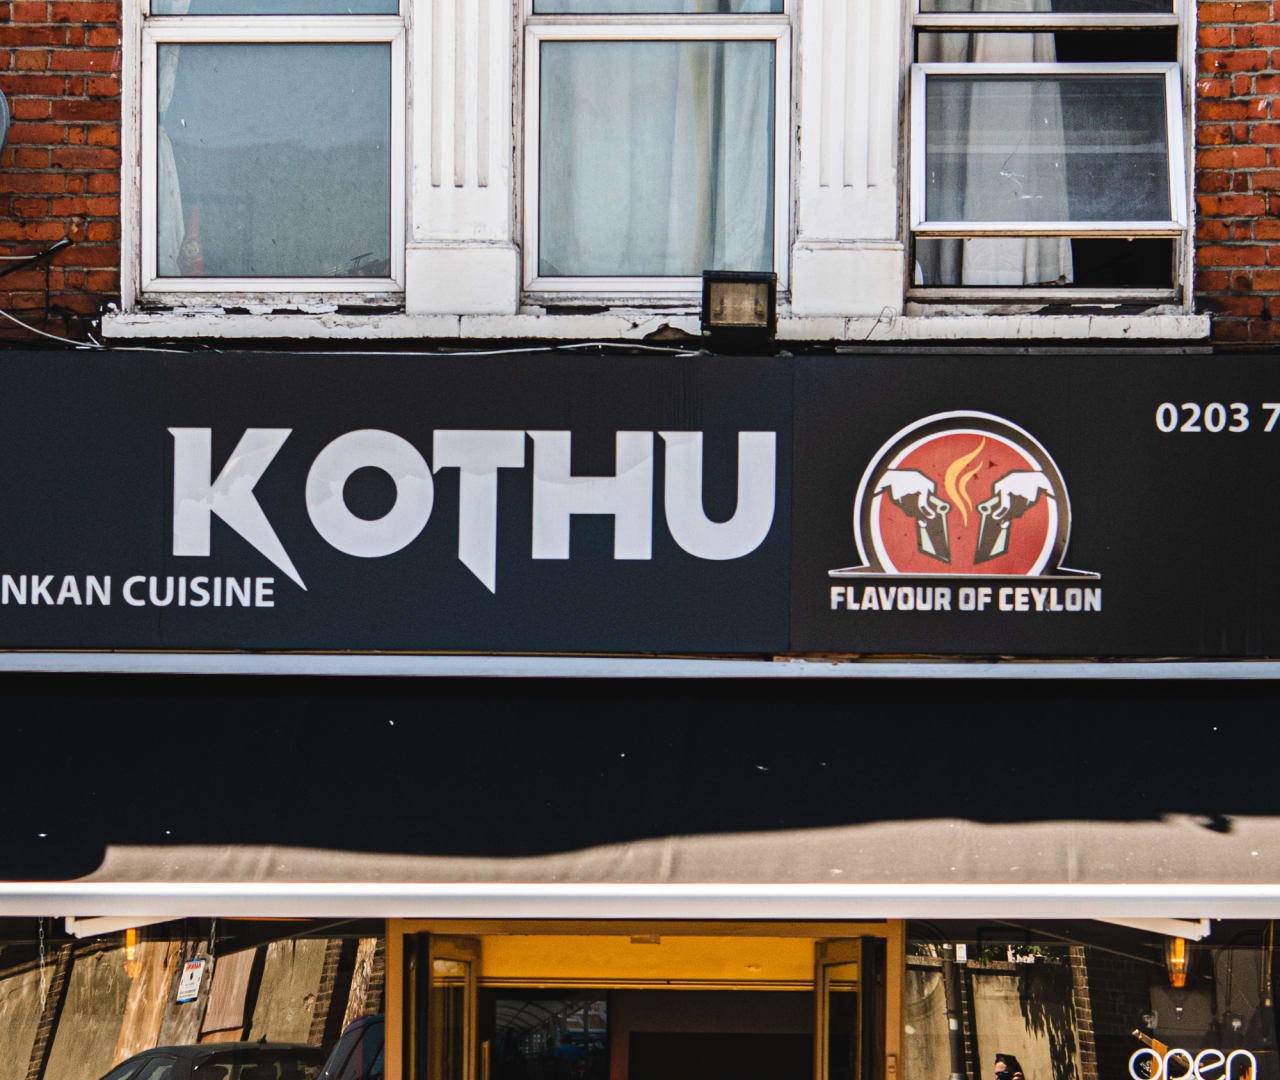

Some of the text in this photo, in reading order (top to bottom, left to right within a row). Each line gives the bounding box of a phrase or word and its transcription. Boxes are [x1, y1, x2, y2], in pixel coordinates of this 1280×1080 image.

[1155, 402, 1251, 433] 0203
[167, 427, 778, 594] KOTHU
[122, 575, 275, 608] CUISINE
[829, 586, 1102, 612] FLAVOUR OF CEYLON
